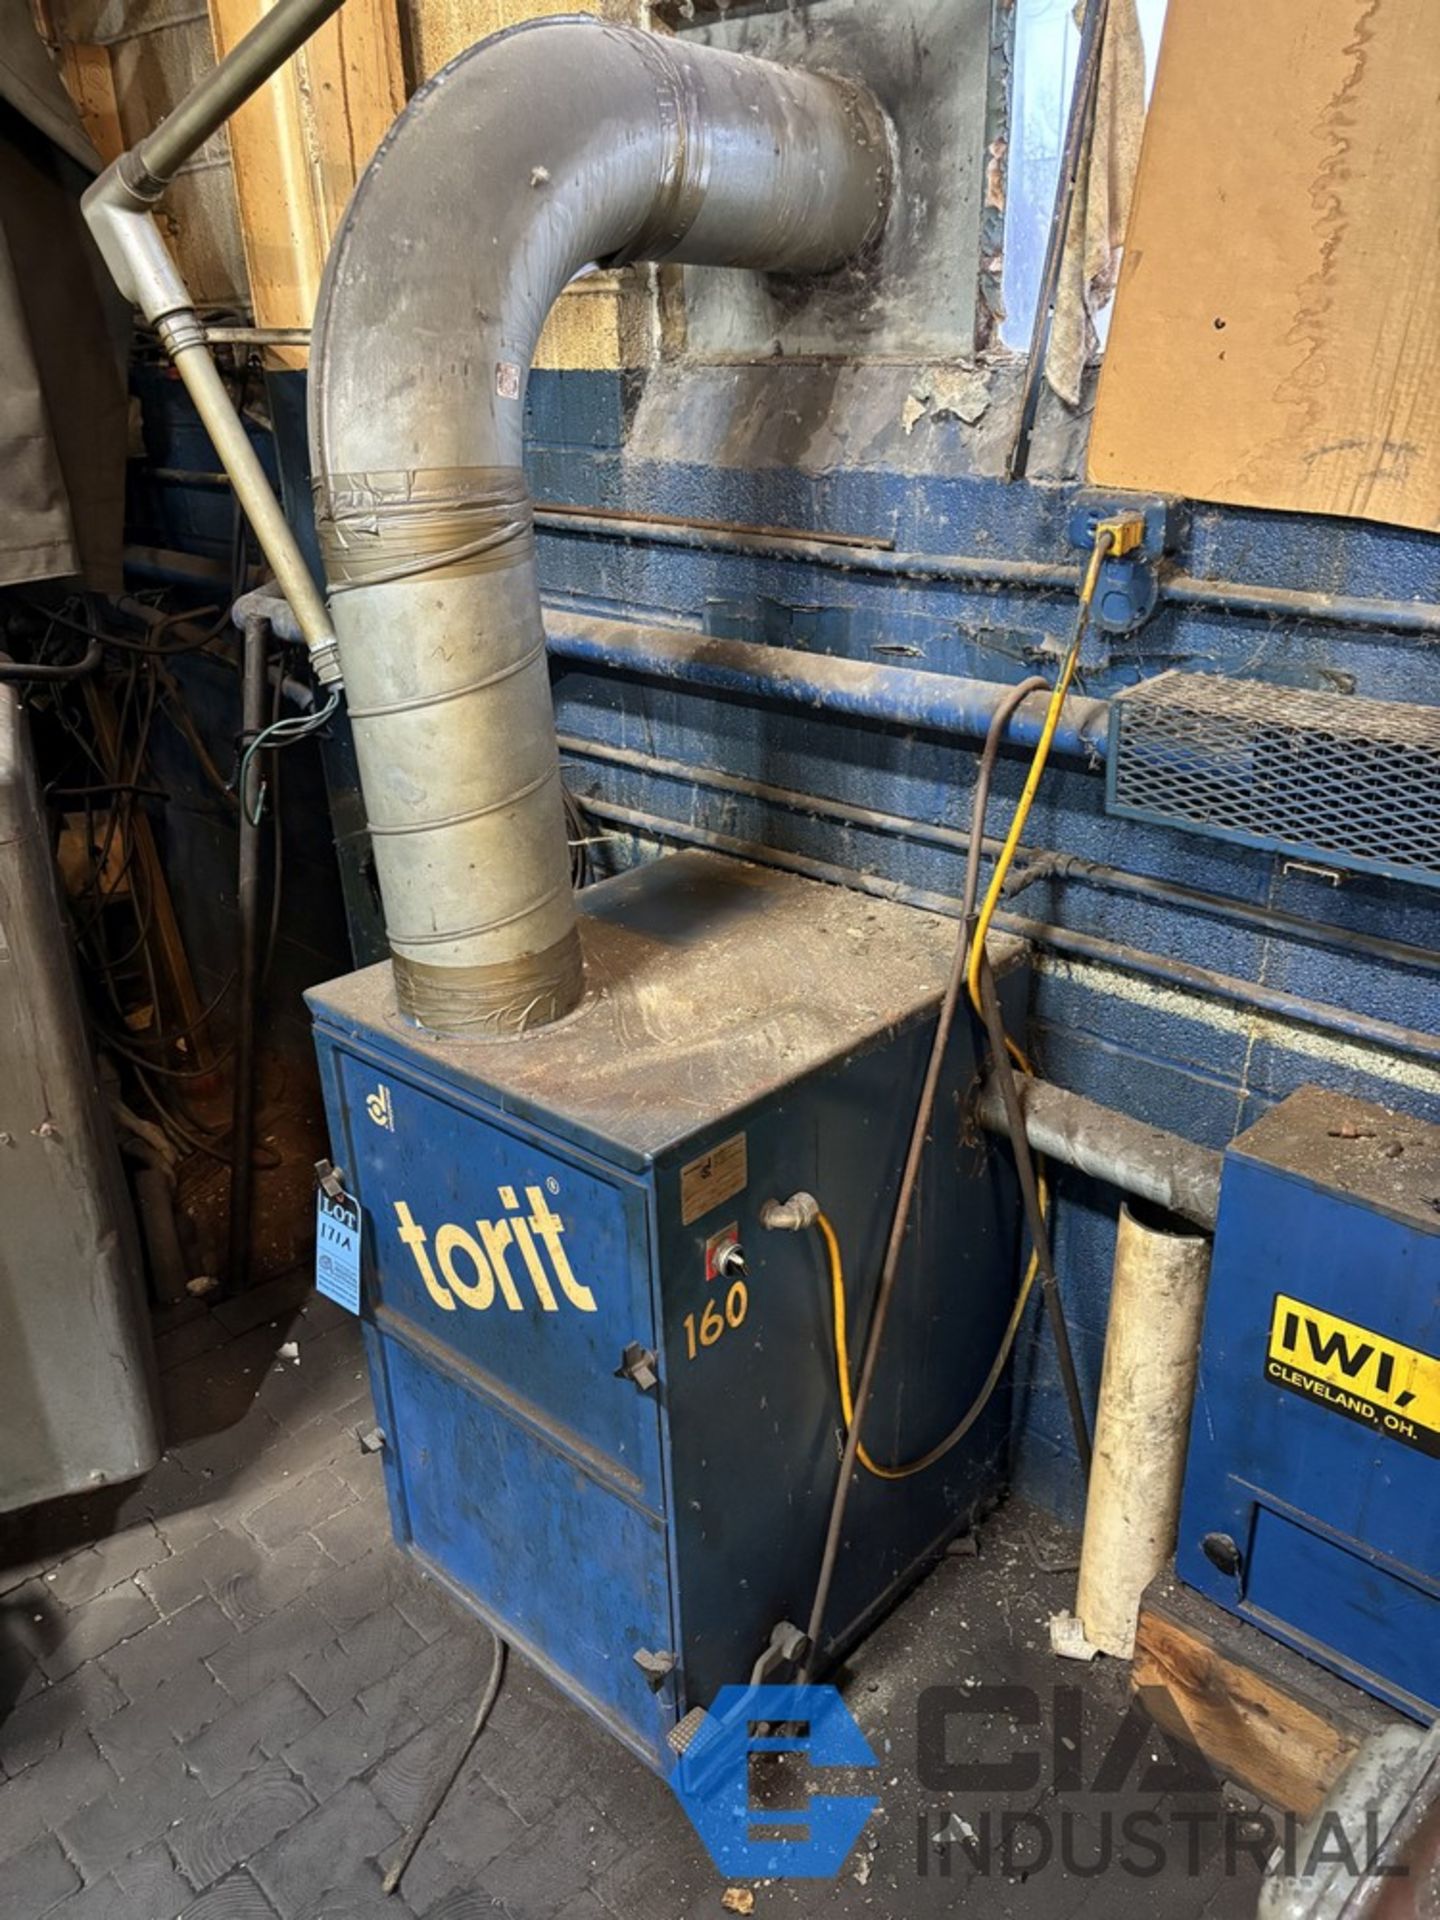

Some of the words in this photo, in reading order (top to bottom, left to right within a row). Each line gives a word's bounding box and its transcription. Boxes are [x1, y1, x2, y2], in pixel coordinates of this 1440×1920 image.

[323, 1197, 357, 1228] LOT
[684, 1280, 748, 1361] 160
[1268, 1362, 1379, 1424] CLEVELAND,
[1383, 1414, 1418, 1440] OH.
